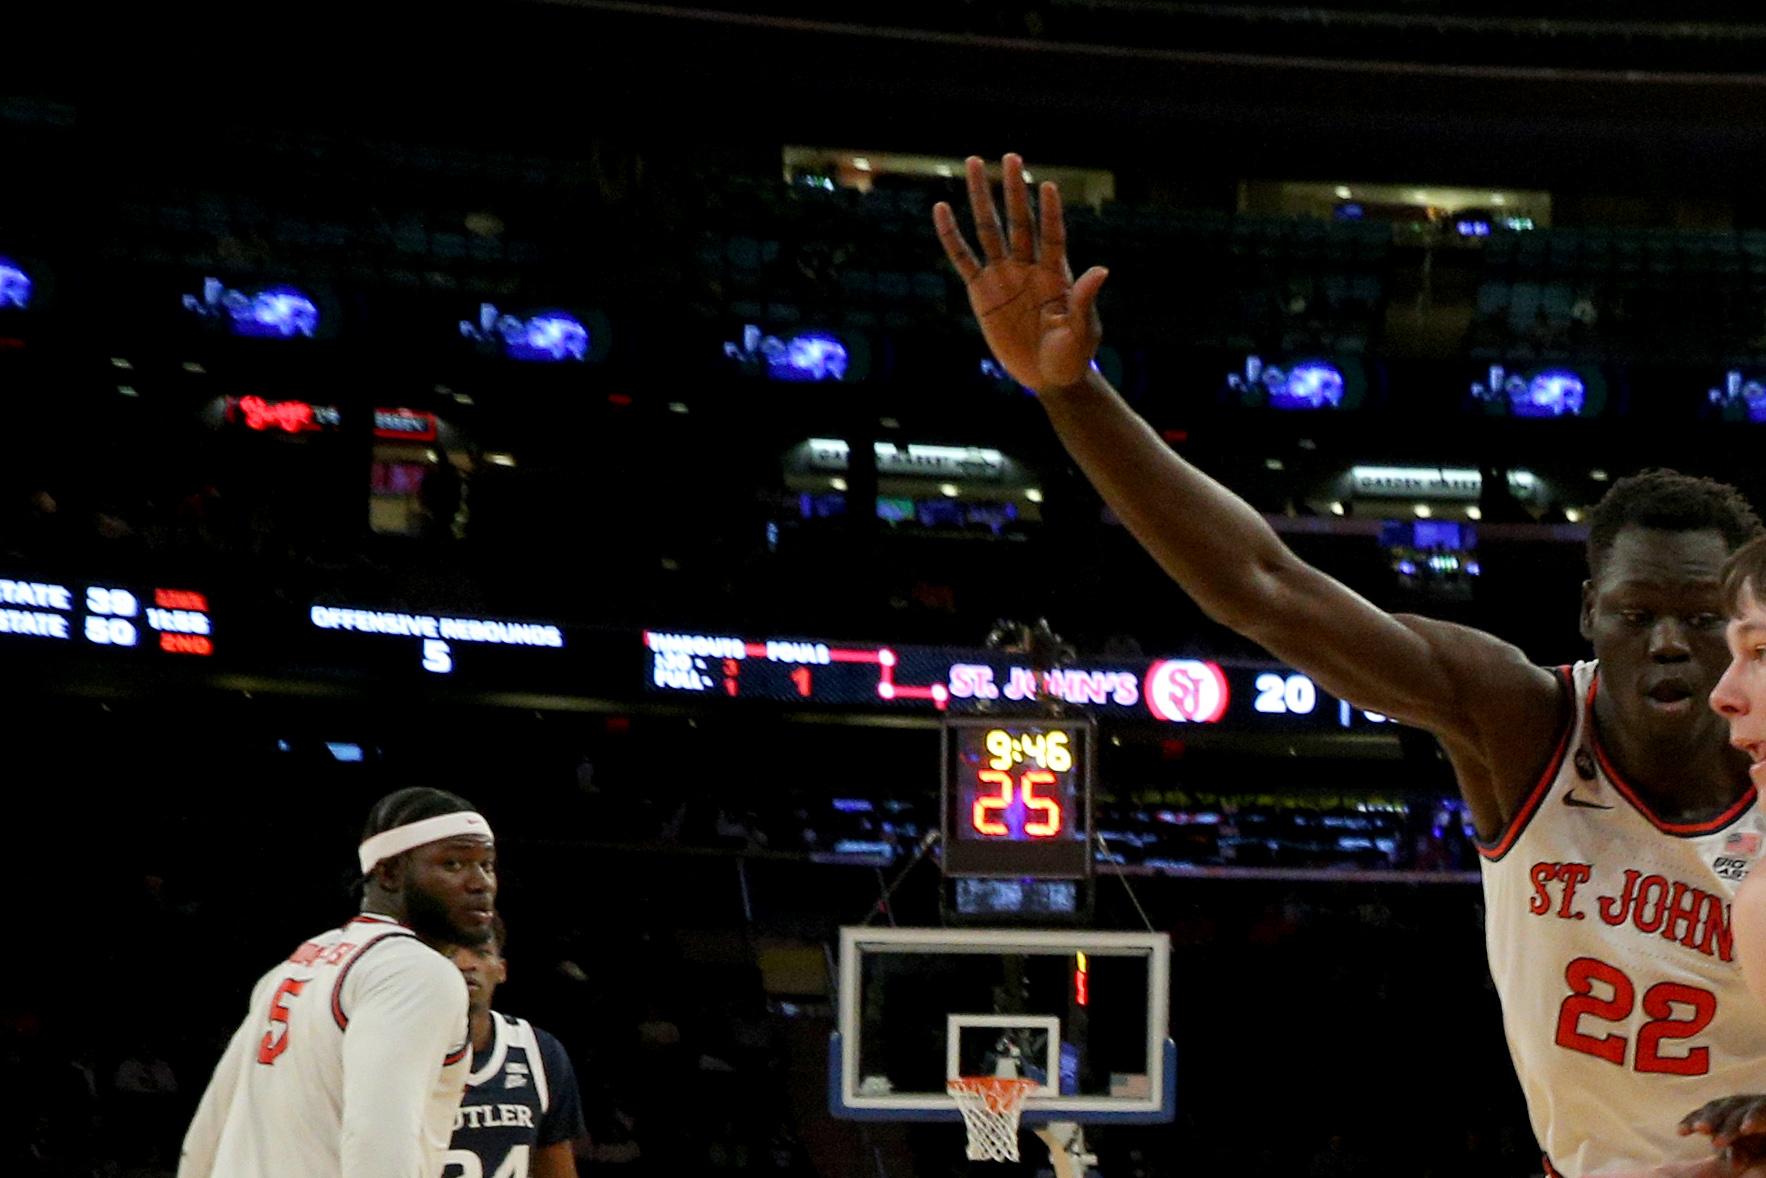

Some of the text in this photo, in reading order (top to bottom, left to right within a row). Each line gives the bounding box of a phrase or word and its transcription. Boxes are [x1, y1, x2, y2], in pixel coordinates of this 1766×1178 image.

[422, 638, 452, 673] 5
[790, 665, 812, 697] 1
[949, 663, 999, 699] ST.
[1254, 673, 1316, 713] 20
[985, 730, 1072, 772] 9:46
[972, 770, 1062, 837] 25
[1530, 861, 1592, 921] ST.
[258, 977, 312, 1065] 5
[1555, 956, 1718, 1077] 22
[452, 1104, 534, 1128] UTLER
